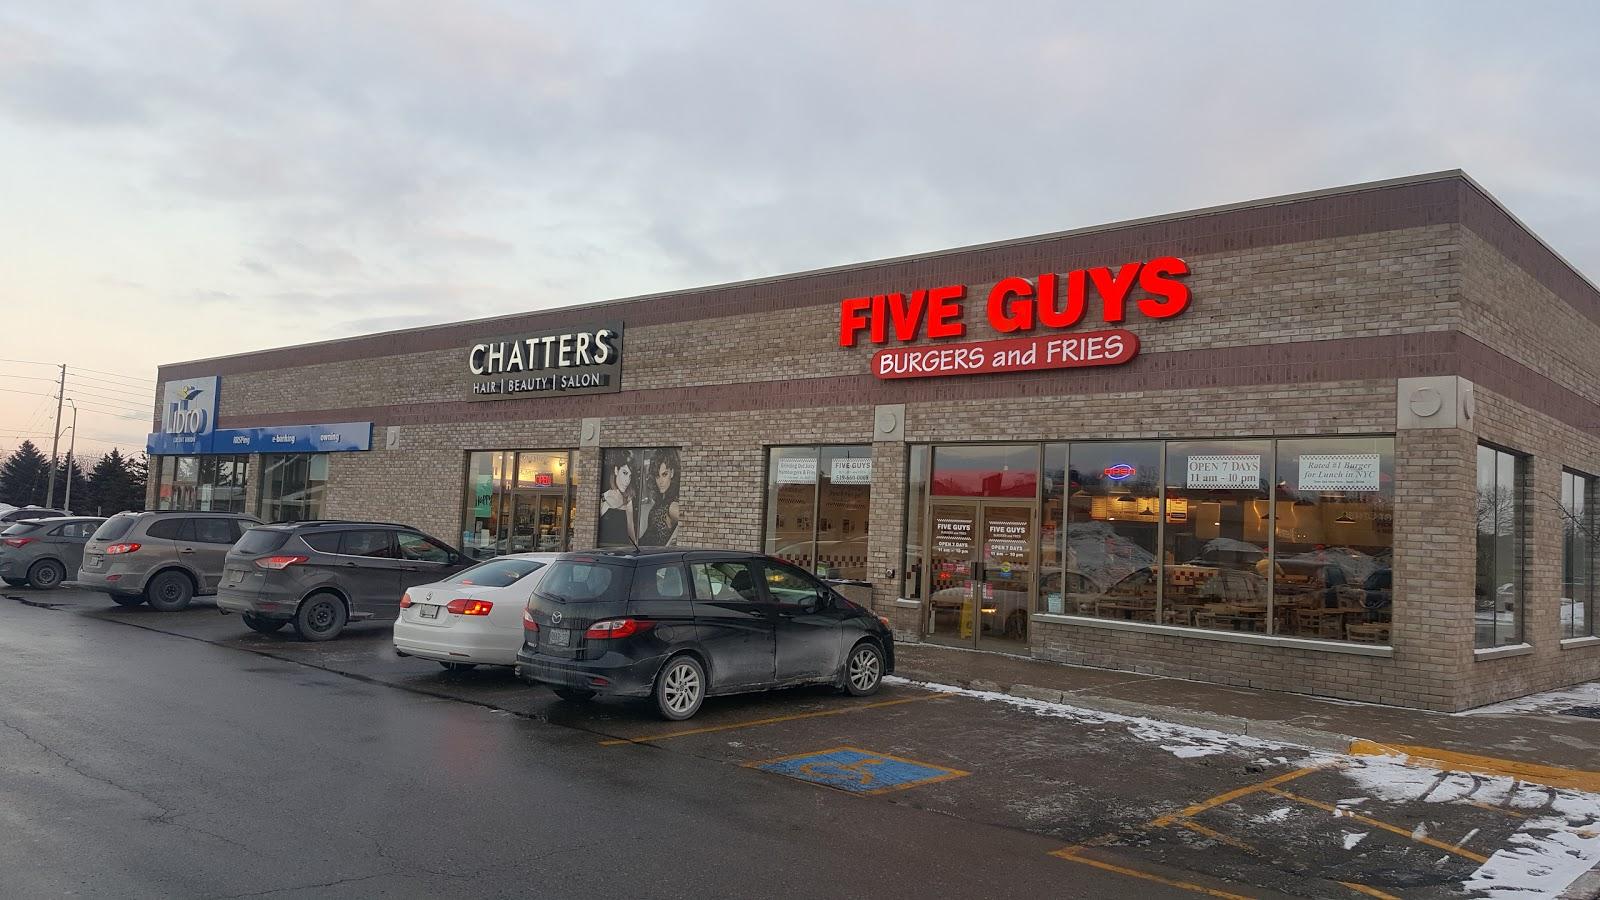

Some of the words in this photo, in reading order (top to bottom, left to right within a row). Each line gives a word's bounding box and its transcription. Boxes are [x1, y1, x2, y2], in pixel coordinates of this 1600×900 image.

[839, 284, 966, 347] FIVE
[987, 256, 1192, 333] GUYS
[469, 329, 612, 375] CHATTERS
[879, 347, 985, 374] BURGERS
[992, 343, 1036, 368] and
[1046, 335, 1124, 363] FRIES
[473, 381, 496, 394] HAIR
[508, 377, 548, 392] BEAUTY
[561, 373, 600, 389] SALON
[272, 434, 295, 444] e-banking
[320, 433, 340, 443] owning
[1189, 462, 1218, 471] OPEN
[1222, 462, 1228, 471] 7
[1232, 461, 1259, 471] DAYS
[1308, 461, 1331, 469] Rated
[1344, 462, 1372, 471] Burger
[1190, 474, 1199, 482] 11
[1229, 474, 1237, 482] 10
[1241, 475, 1256, 484] pm
[1304, 470, 1317, 479] for
[1318, 470, 1343, 478] Lunch
[1355, 470, 1375, 478] NYC
